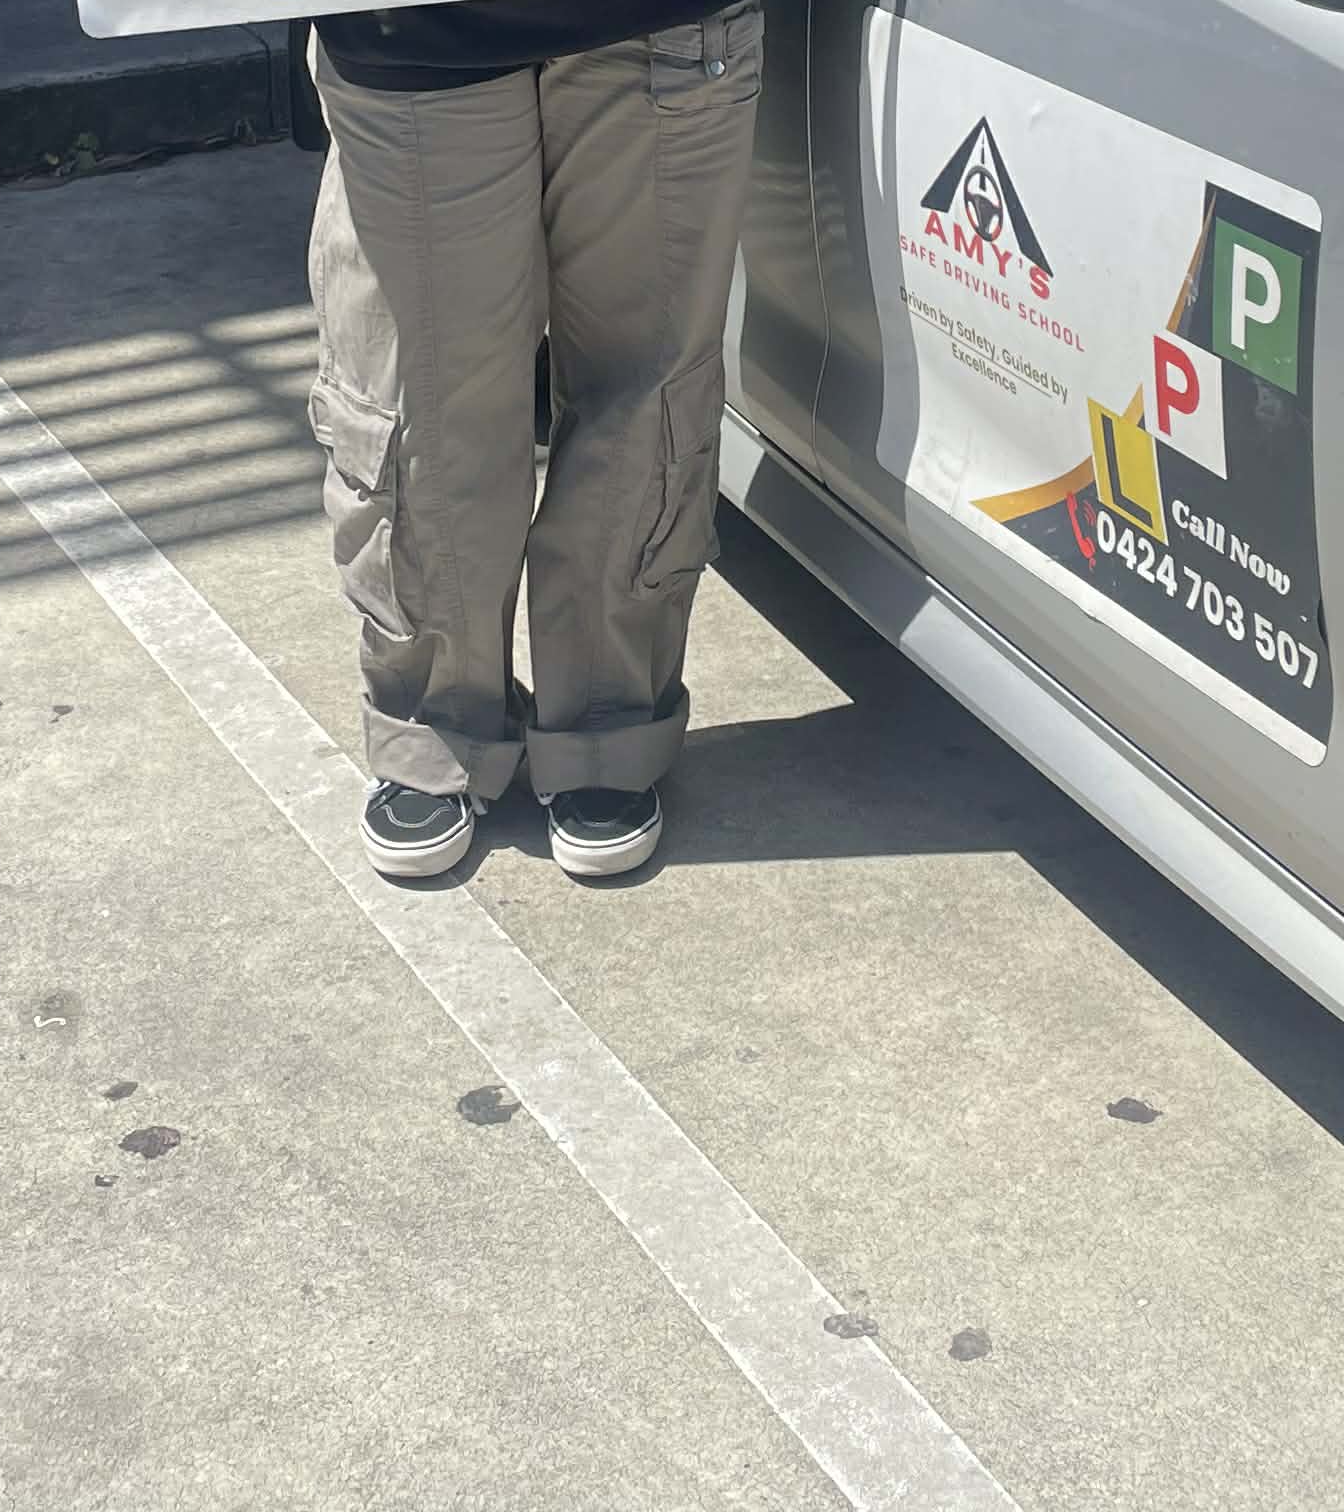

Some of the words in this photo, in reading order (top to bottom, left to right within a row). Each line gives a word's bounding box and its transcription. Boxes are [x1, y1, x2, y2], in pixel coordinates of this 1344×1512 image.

[899, 233, 937, 269] SAFE
[943, 258, 1010, 310] DRIVING
[1018, 301, 1085, 353] SCHOOL
[924, 210, 1050, 300] AMY'S
[1231, 243, 1282, 351] P
[899, 285, 937, 320] Driven
[939, 309, 954, 337] by
[1002, 349, 1049, 389] Guided
[1051, 375, 1068, 405] by
[951, 341, 1017, 395] Excellence
[1153, 334, 1200, 437] P
[1101, 412, 1154, 530] L
[1096, 510, 1177, 598] 0424
[1183, 565, 1245, 641] 703
[1254, 612, 1318, 689] 507
[1172, 499, 1225, 555] Call
[1229, 534, 1291, 596] Now
